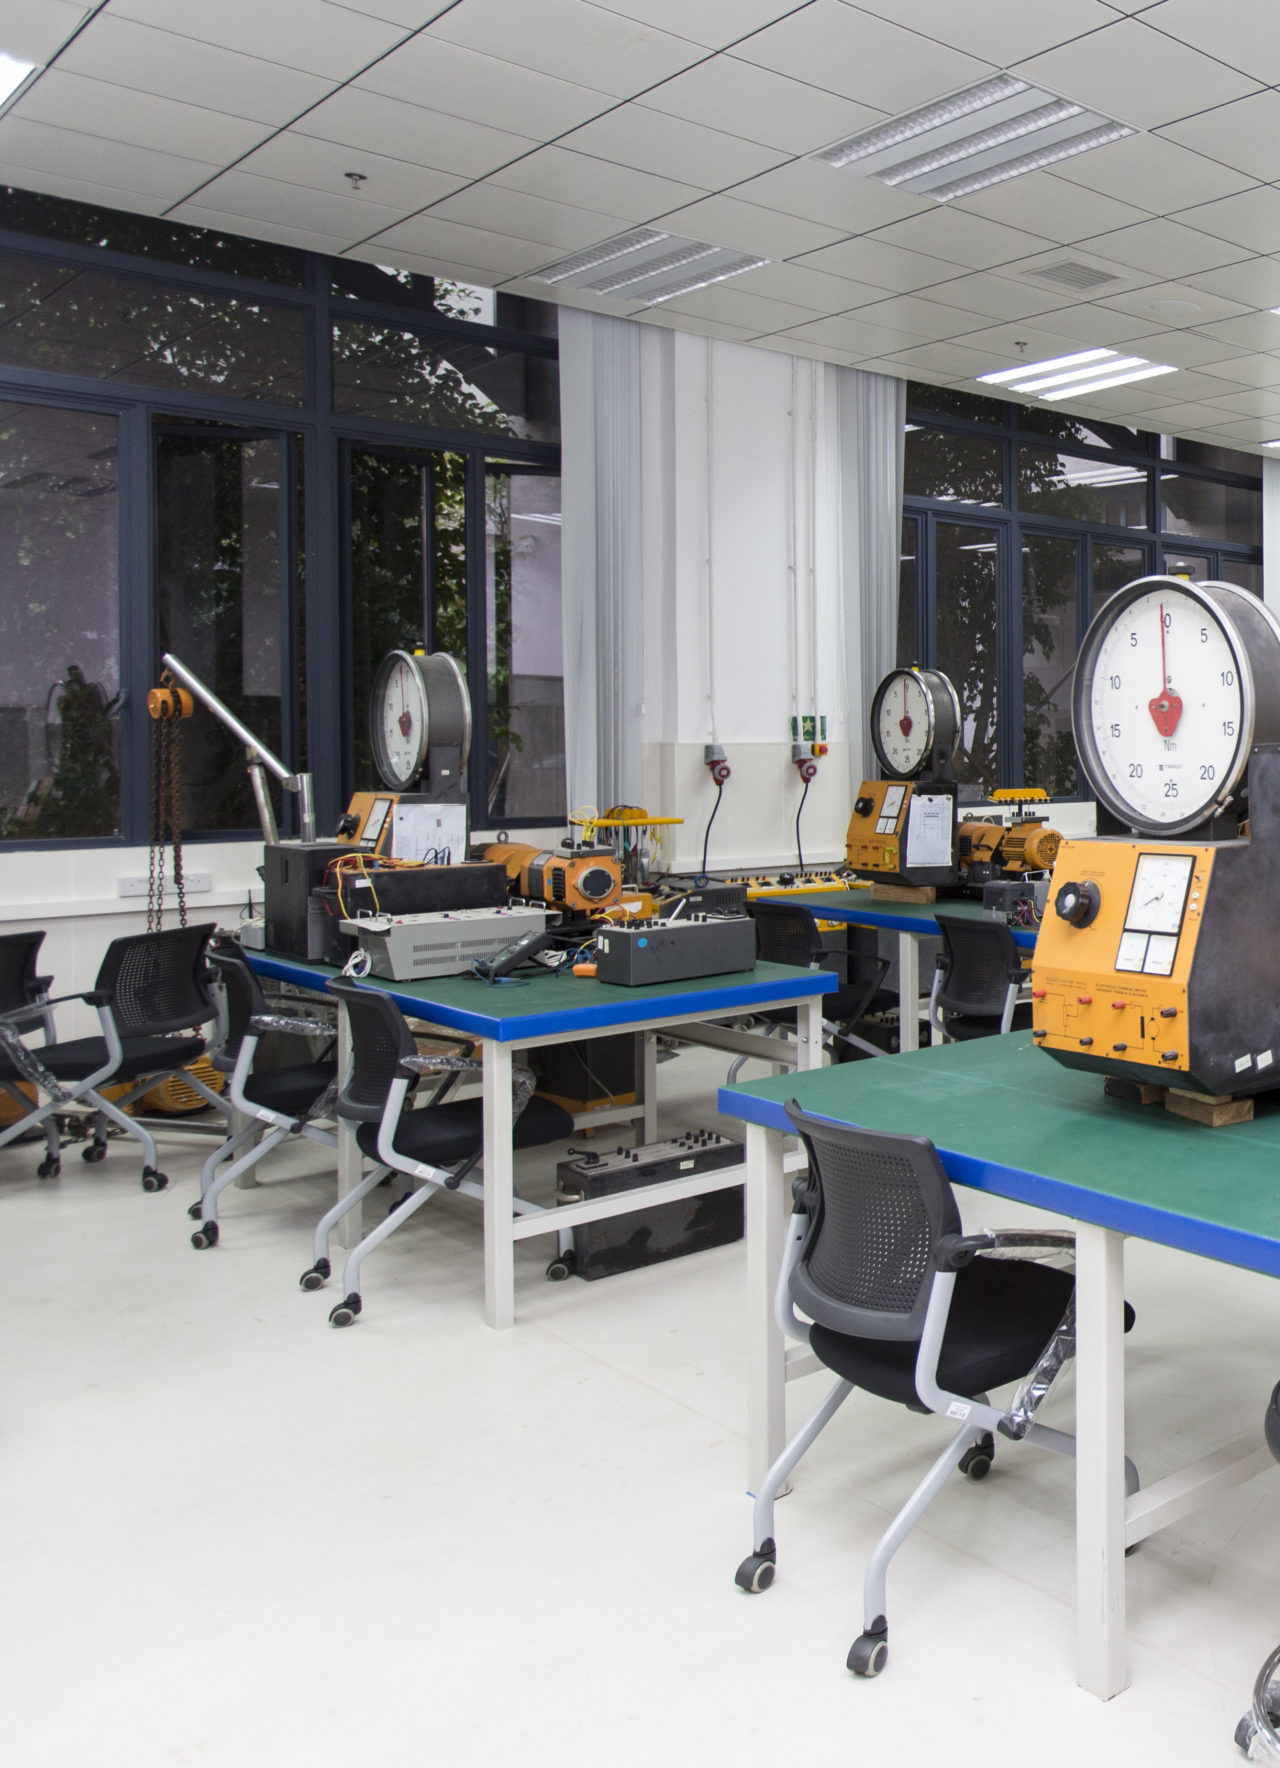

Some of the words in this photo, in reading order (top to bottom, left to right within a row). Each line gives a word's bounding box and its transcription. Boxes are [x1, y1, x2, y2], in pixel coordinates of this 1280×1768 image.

[1163, 613, 1172, 628] 0
[1130, 633, 1138, 647] 5
[1200, 628, 1208, 643] 5
[1109, 675, 1121, 690] 10
[1220, 670, 1234, 686] 10
[1110, 724, 1121, 738] 15
[1222, 721, 1235, 736] 15
[1163, 739, 1177, 752] Nm
[1128, 763, 1143, 779] 20
[1199, 765, 1215, 780] 20
[1164, 783, 1179, 798] 25
